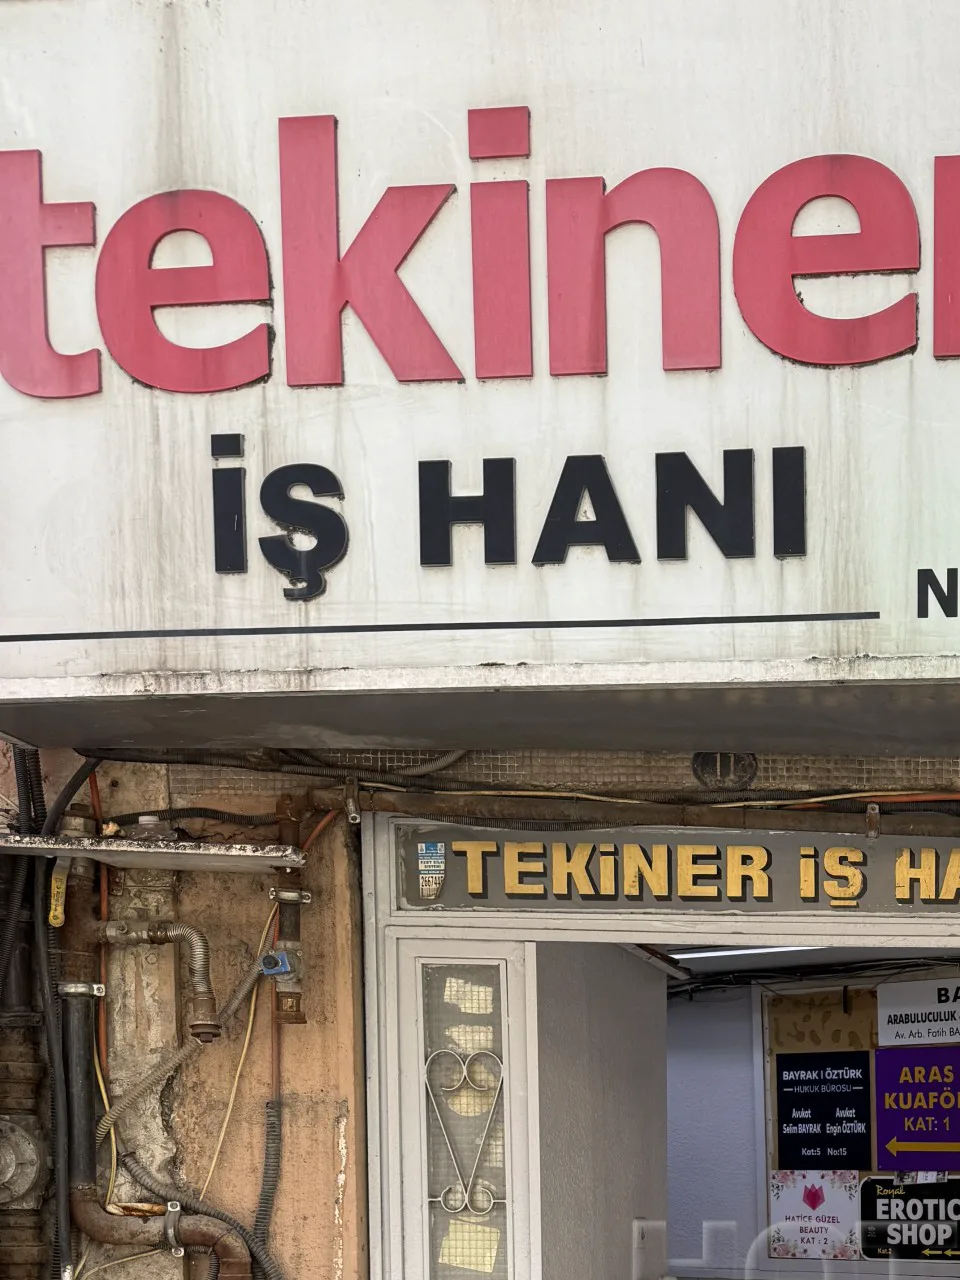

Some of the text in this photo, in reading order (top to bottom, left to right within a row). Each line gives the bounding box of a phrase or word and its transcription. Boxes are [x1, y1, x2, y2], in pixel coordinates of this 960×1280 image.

[210, 432, 807, 600] İŞ HANI
[887, 1009, 957, 1026] ARABULUCULUK
[894, 1030, 906, 1040] Av.
[908, 1028, 925, 1040] Arb.
[927, 1027, 947, 1039] Fatih
[782, 1070, 819, 1081] BAYRAK
[825, 1066, 863, 1079] ÖZTÜRK
[899, 1065, 955, 1083] ARAS
[794, 1083, 852, 1094] HUKUK BÜROSU
[791, 1108, 812, 1119] Avukat
[835, 1107, 856, 1118] Avukat
[798, 1123, 822, 1134] BAYRAK
[842, 1120, 867, 1134] ÖZTÜRK
[904, 1116, 950, 1131] KAT: 1
[875, 1183, 906, 1198] Royal
[785, 1213, 841, 1224] HATİCE GÜZEL
[799, 1226, 829, 1234] BEAUTY
[886, 1222, 953, 1246] SHOP
